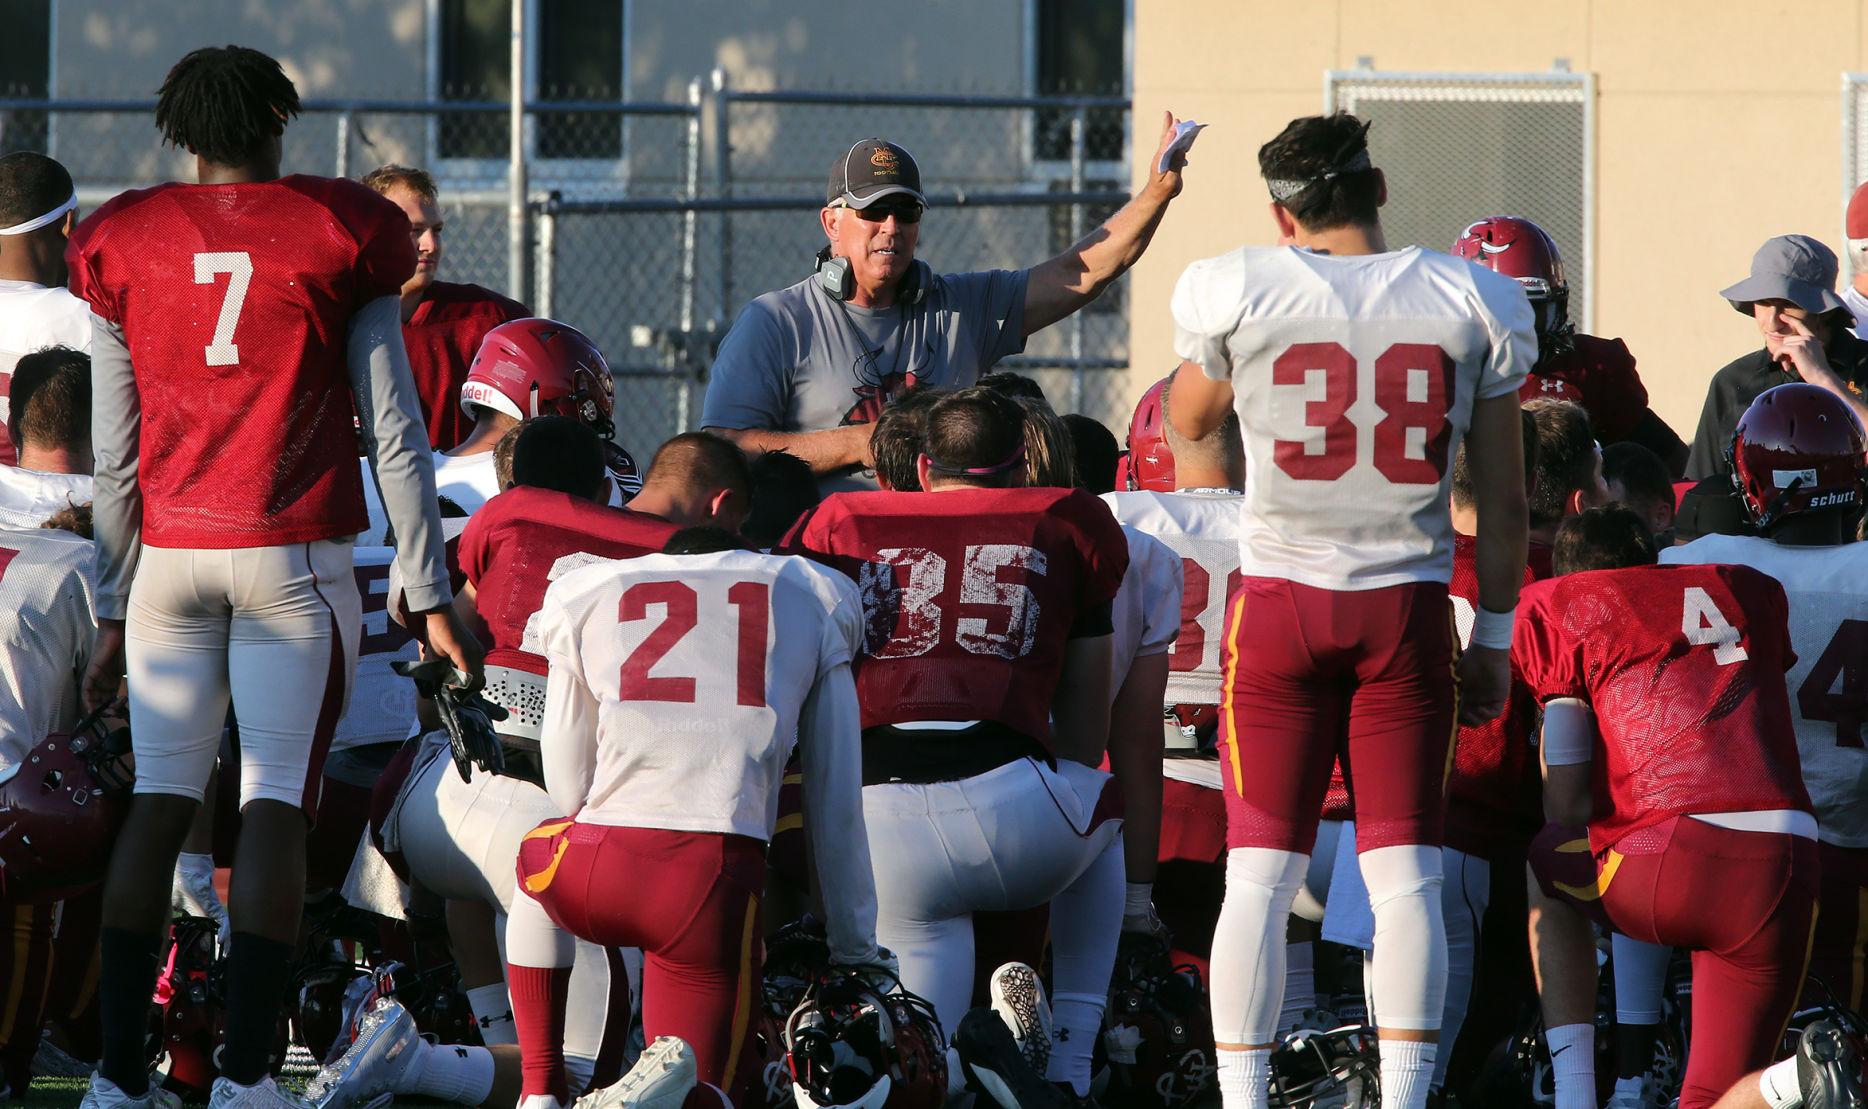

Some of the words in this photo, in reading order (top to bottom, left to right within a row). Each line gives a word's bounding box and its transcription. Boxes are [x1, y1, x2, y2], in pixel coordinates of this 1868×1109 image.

[193, 251, 254, 367] 7
[462, 385, 493, 404] ddell
[1273, 341, 1456, 485] 38
[1193, 487, 1241, 496] ARMOUR
[1810, 491, 1855, 507] schutt
[618, 580, 769, 708] 21
[1682, 587, 1749, 665] 4
